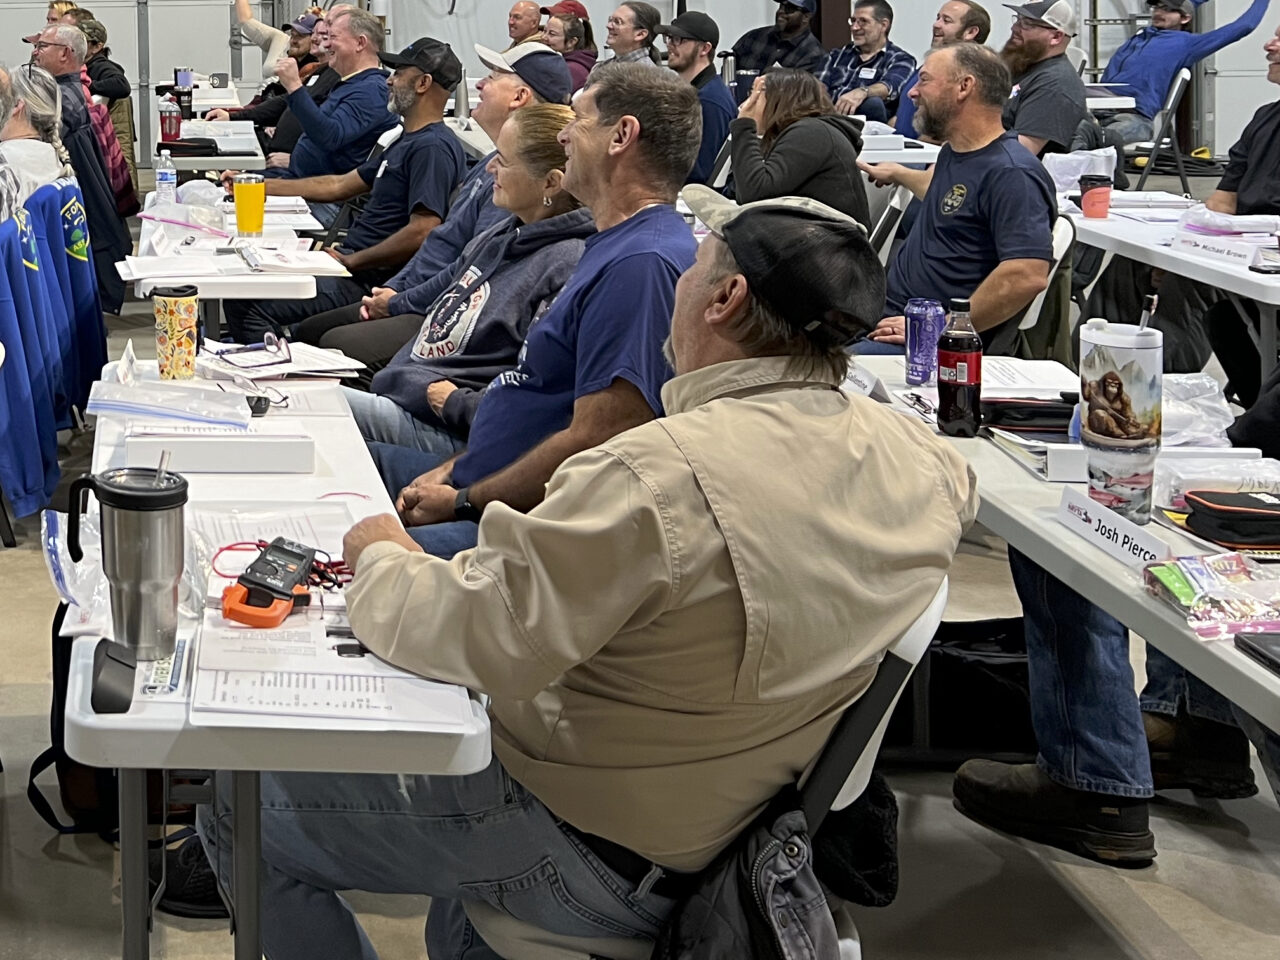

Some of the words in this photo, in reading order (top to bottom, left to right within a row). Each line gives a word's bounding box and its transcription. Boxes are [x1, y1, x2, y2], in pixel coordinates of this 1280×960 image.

[1201, 244, 1226, 255] Michael
[1094, 518, 1119, 544] Josh
[1122, 534, 1157, 562] Pierce
[1210, 560, 1238, 571] RITZ
